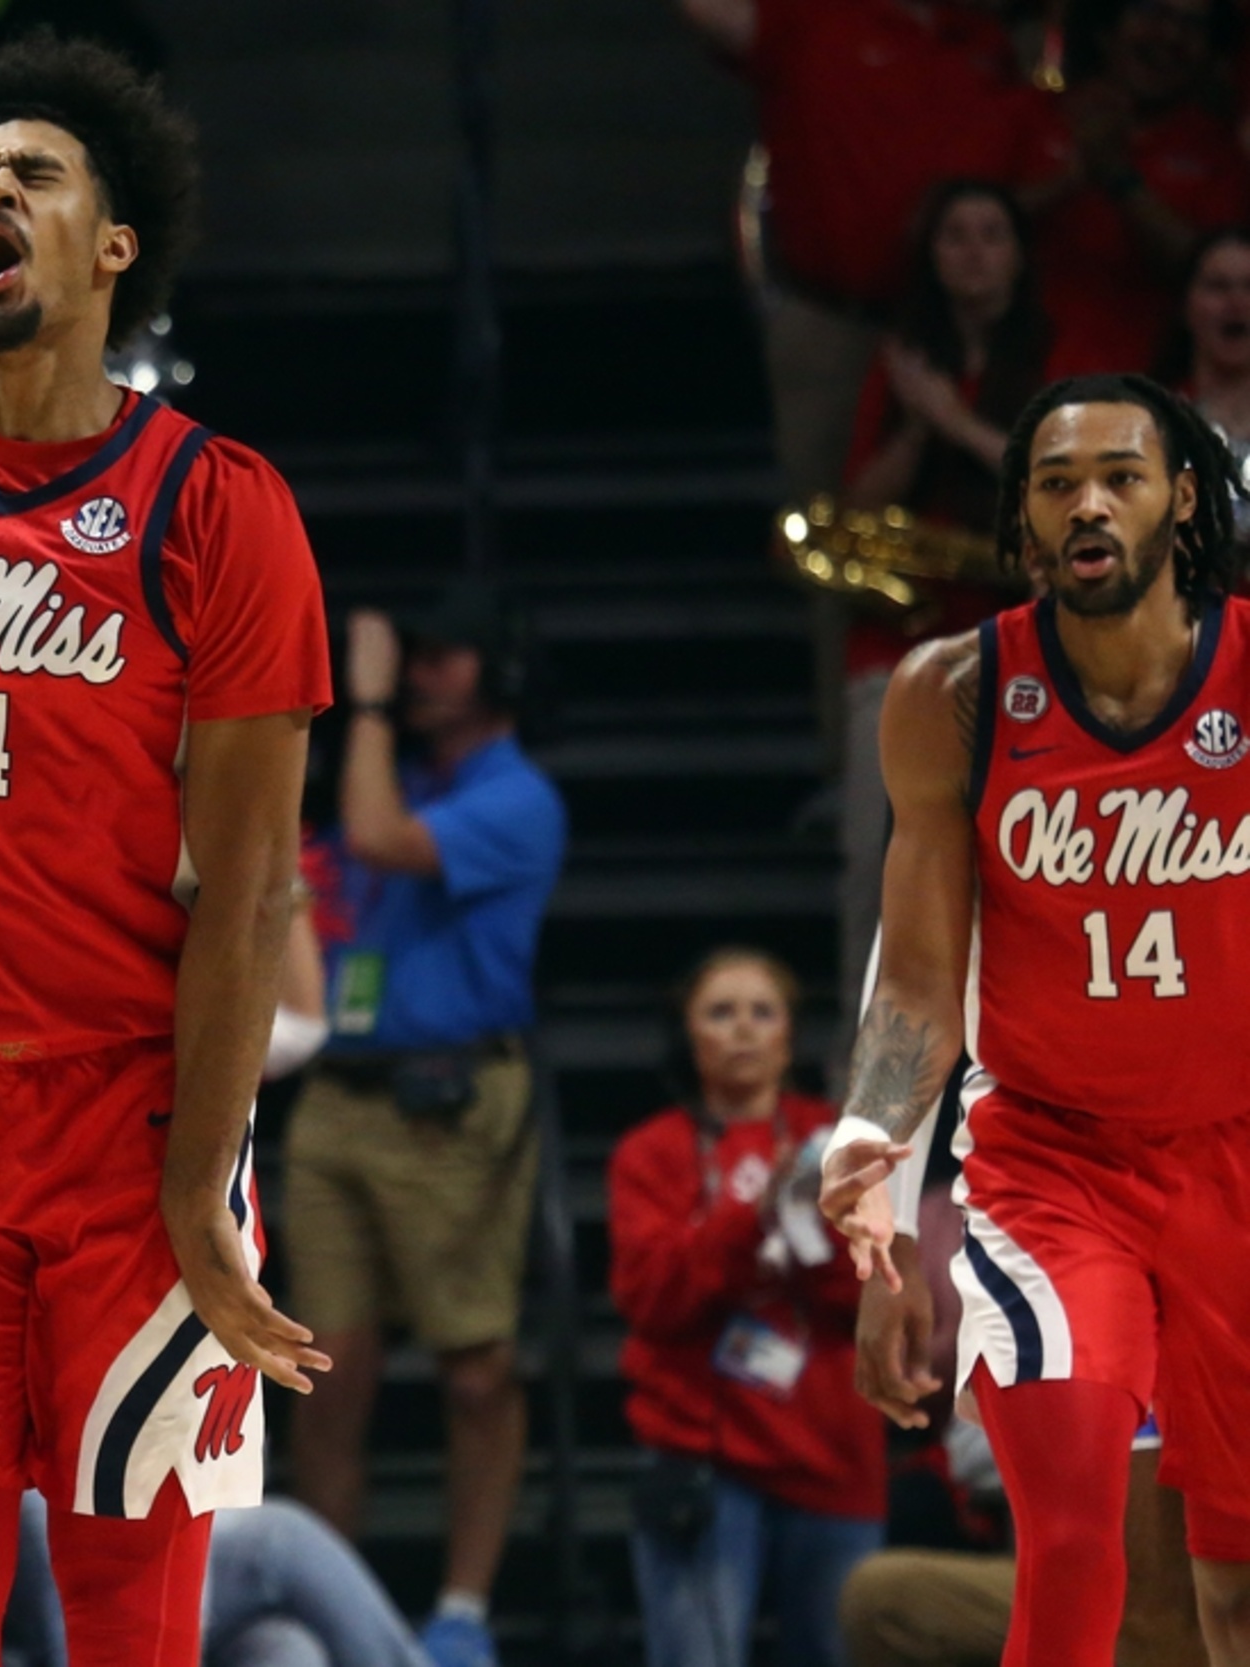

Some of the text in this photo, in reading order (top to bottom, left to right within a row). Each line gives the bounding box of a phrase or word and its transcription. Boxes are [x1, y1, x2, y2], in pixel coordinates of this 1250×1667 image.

[77, 498, 126, 538] SEC
[1196, 710, 1239, 752] SEC
[998, 786, 1096, 886] Ole
[1083, 910, 1188, 998] 14
[193, 1361, 259, 1464] M
